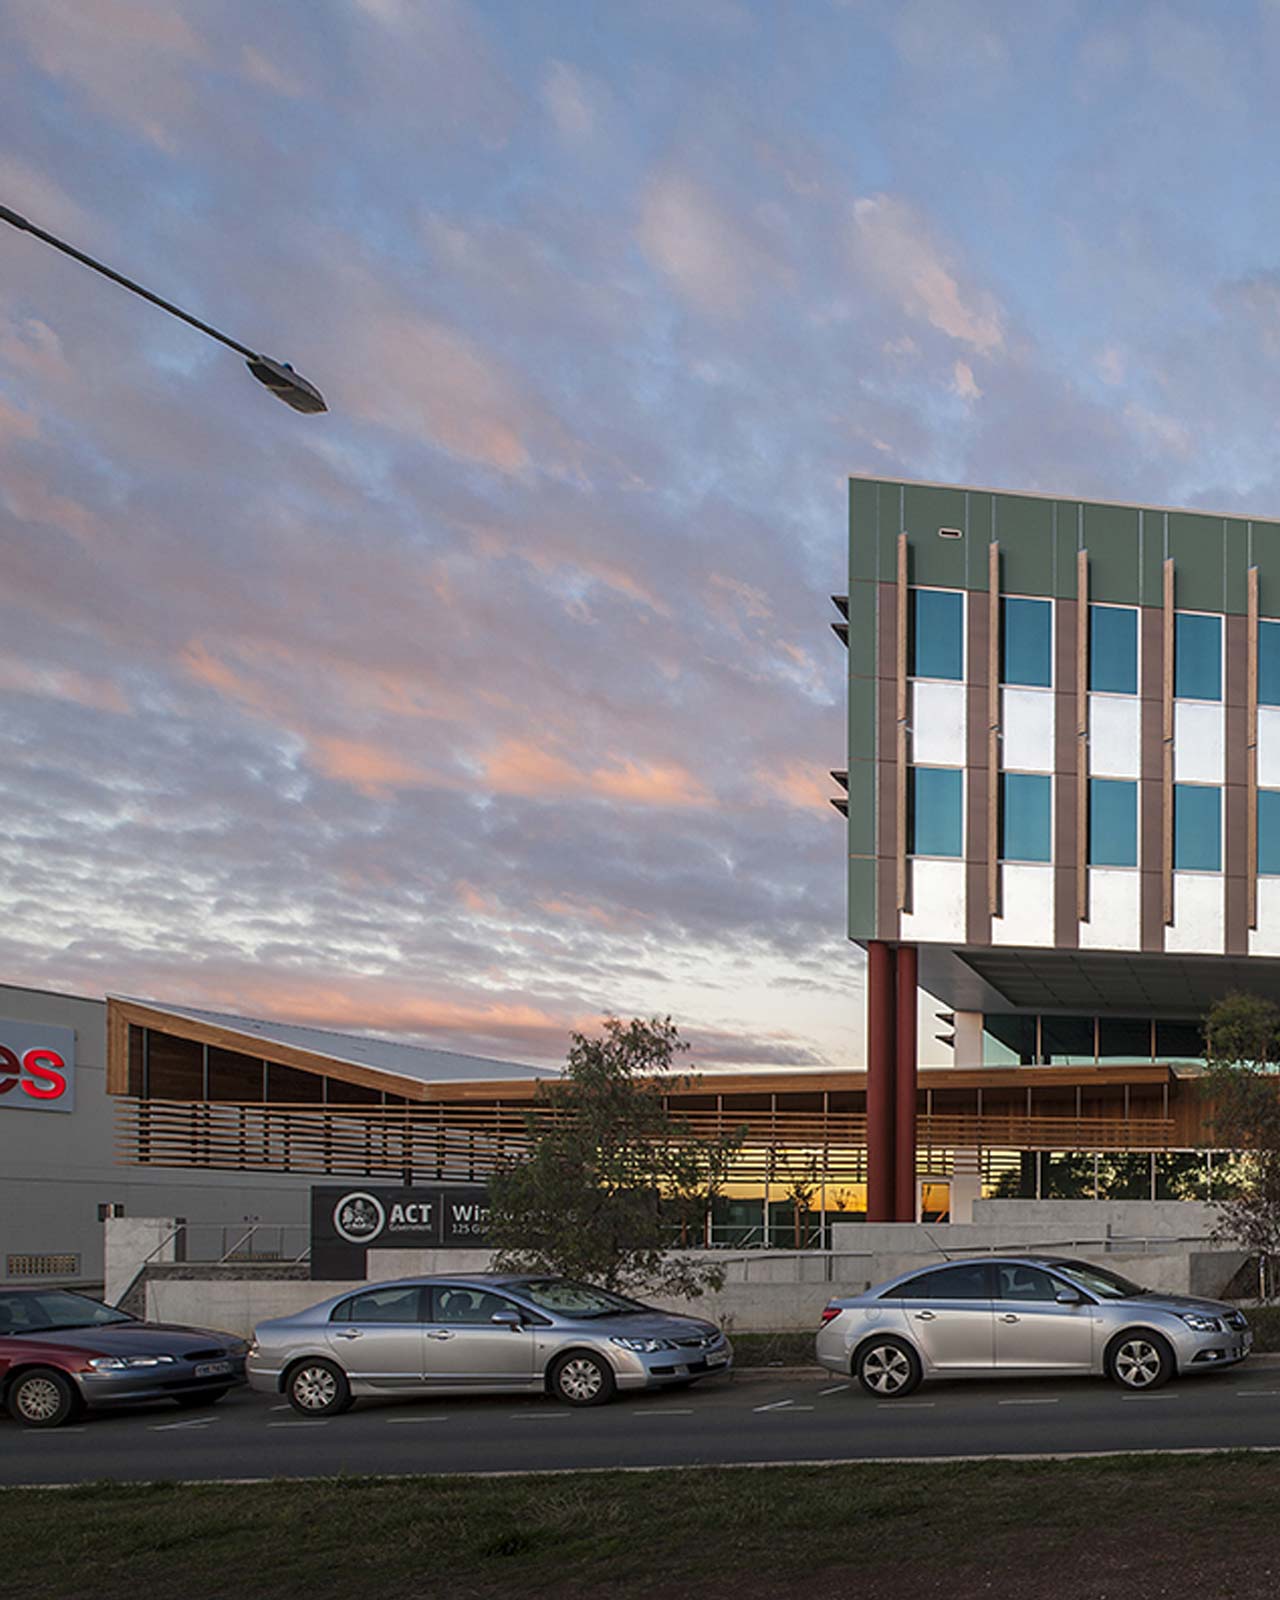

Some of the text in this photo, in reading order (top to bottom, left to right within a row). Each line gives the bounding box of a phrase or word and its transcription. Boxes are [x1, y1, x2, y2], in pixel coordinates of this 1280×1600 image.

[390, 1204, 432, 1222] ACT
[388, 1223, 432, 1232] Government
[452, 1223, 470, 1234] 125
